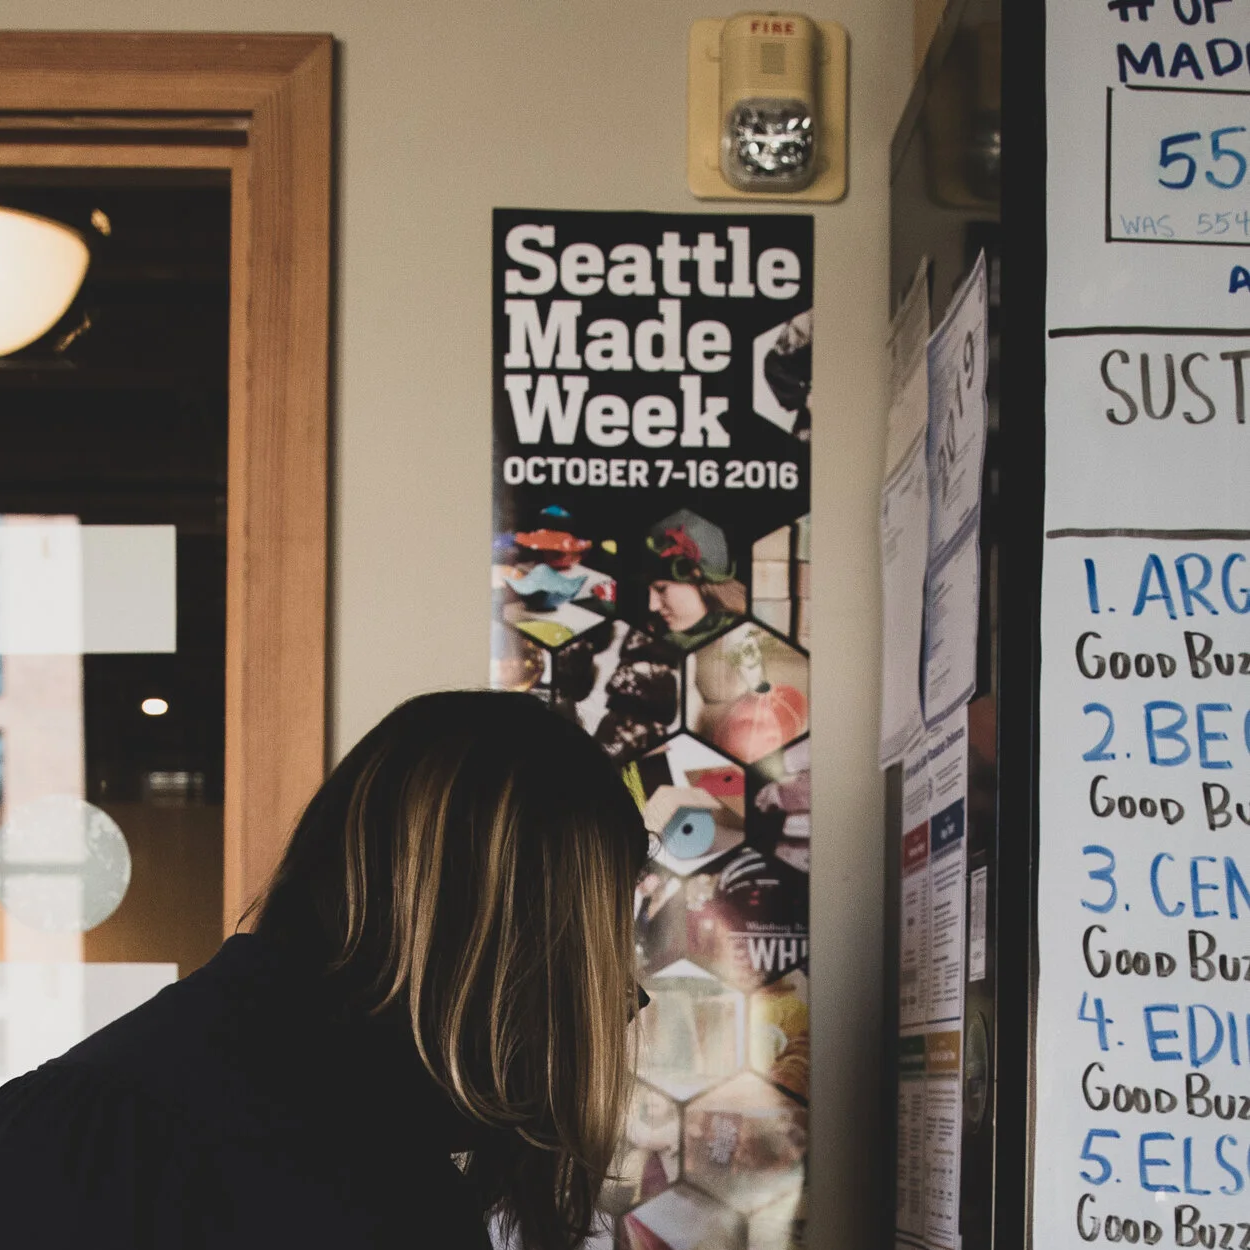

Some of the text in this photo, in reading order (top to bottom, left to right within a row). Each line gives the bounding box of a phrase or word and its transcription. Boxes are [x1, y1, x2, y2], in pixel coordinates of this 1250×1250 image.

[751, 20, 795, 35] FIRE
[1117, 38, 1250, 83] MAD
[505, 224, 800, 299] Seattle
[504, 299, 732, 372] Made
[504, 374, 730, 448] Week
[503, 456, 799, 489] OCTOBER 7-16 2016
[1144, 700, 1250, 770] BE
[1143, 1004, 1250, 1069] EDI
[1138, 1131, 1250, 1196] ELS
